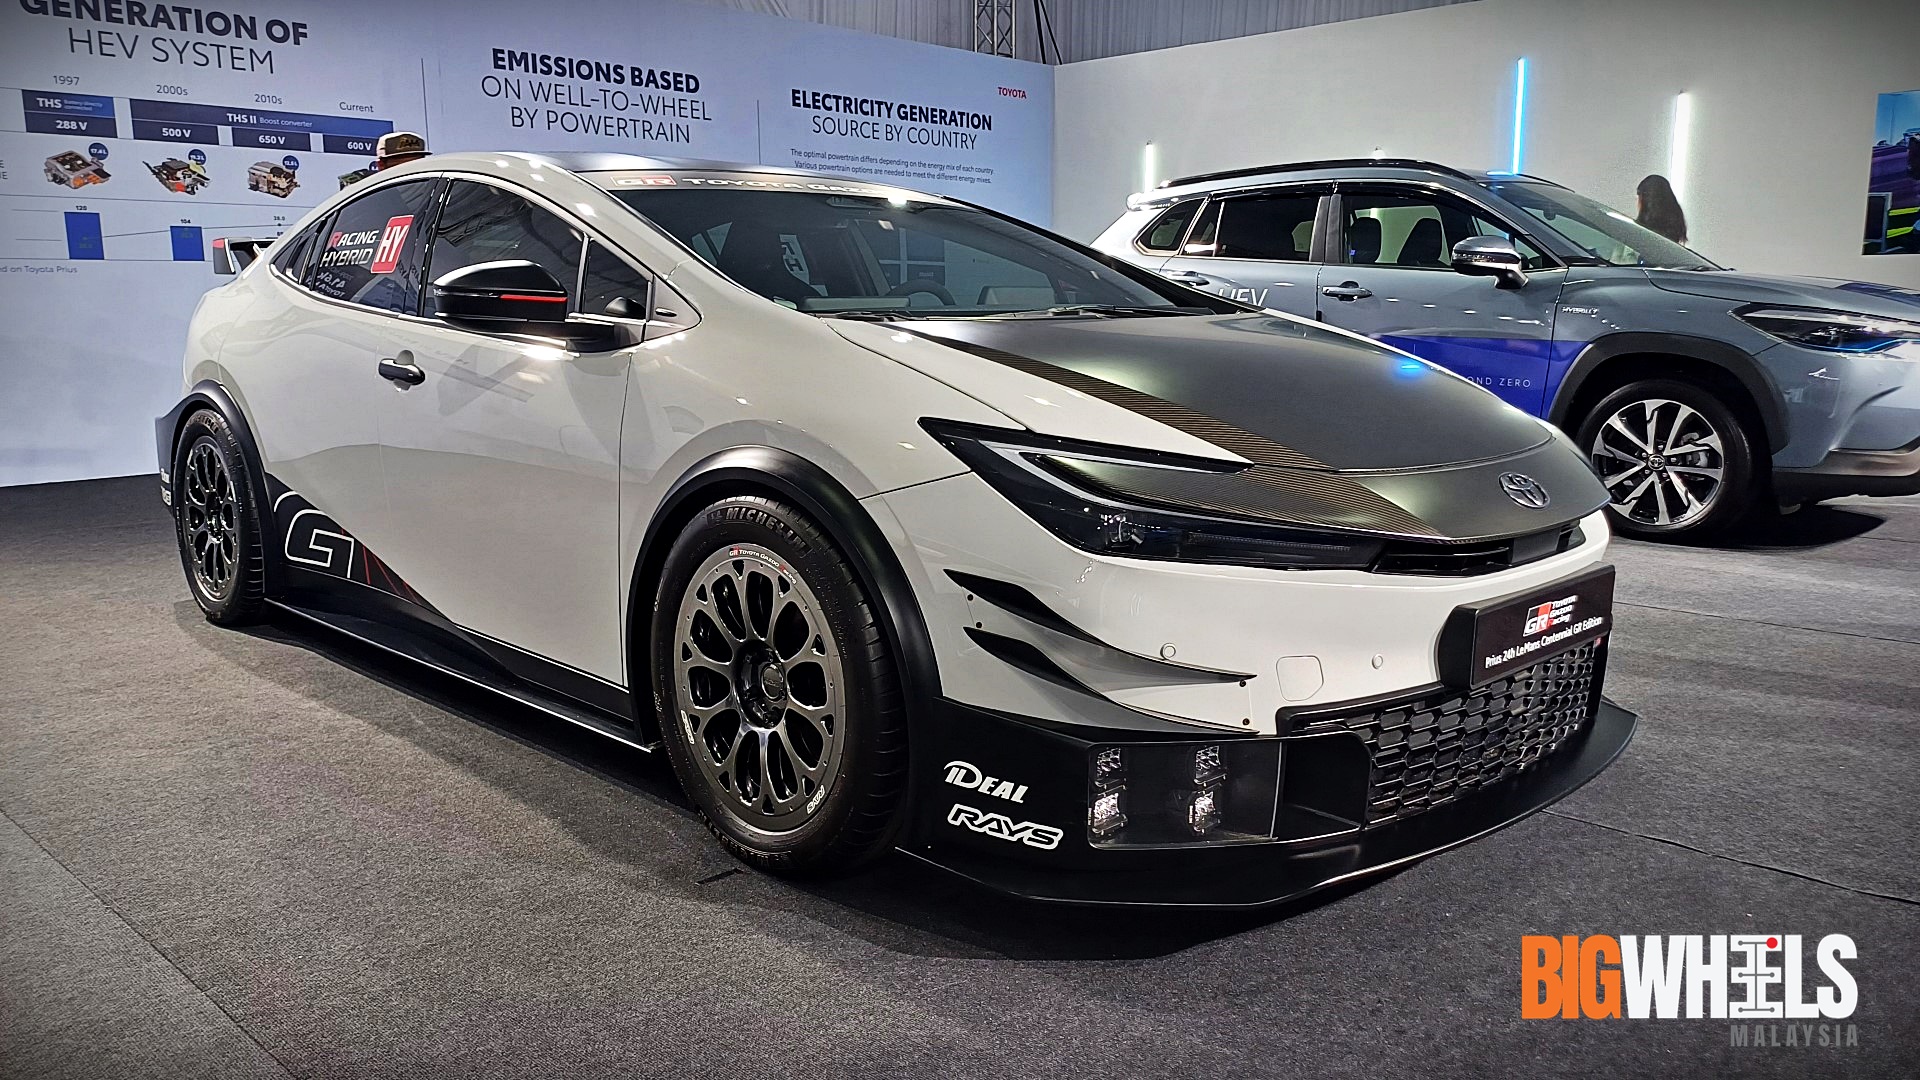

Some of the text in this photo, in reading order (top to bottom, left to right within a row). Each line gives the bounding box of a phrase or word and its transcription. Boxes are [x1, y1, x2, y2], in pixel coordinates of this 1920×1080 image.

[19, 0, 308, 46] GENERATION OF
[68, 27, 274, 74] HEV SYSTEM
[492, 48, 700, 93] EMISSIONS BASED
[53, 75, 80, 86] 1997
[156, 84, 188, 96] 2000s
[254, 93, 283, 105] 2010s
[481, 75, 712, 121] ON WELL-TO-WHEEL
[997, 86, 1027, 99] TOYOTA
[36, 97, 62, 109] THS
[339, 101, 374, 113] Current
[791, 88, 992, 131] ELECTRICITY GENERATION
[56, 120, 88, 131] 288 V
[226, 113, 248, 123] THS
[259, 117, 280, 125] Boost
[281, 119, 313, 128] converter
[511, 106, 691, 143] BY POWERTRAIN
[162, 127, 191, 138] 500 V
[258, 134, 286, 145] 650 V
[812, 115, 977, 150] SOURCE BY COUNTRY
[347, 141, 372, 151] 600 V
[790, 148, 802, 157] The
[803, 151, 827, 160] optimal
[827, 153, 859, 162] powertrain
[860, 155, 878, 164] differs
[879, 157, 908, 168] depending
[918, 160, 927, 168] the
[927, 163, 945, 171] energy
[962, 165, 975, 173] each
[794, 160, 817, 170] Various
[819, 163, 850, 172] powertrain
[851, 166, 873, 175] options
[883, 168, 905, 177] needed
[912, 171, 926, 179] meet
[936, 173, 958, 181] different
[958, 175, 975, 184] energy
[614, 176, 675, 186] GR
[682, 177, 803, 189] TOYOTA
[329, 230, 379, 248] RACING
[374, 225, 410, 263] HY
[320, 248, 373, 267] HYBRID
[24, 265, 54, 275] Toyota
[56, 265, 78, 273] Prius
[1466, 376, 1531, 388] OND ZERO
[1524, 613, 1548, 635] GR
[1485, 654, 1502, 668] Prius
[1502, 647, 1515, 662] 24h
[1541, 624, 1573, 647] Centennial
[1573, 622, 1582, 634] GR
[1582, 616, 1604, 631] Edition
[947, 803, 1064, 850] RAYS
